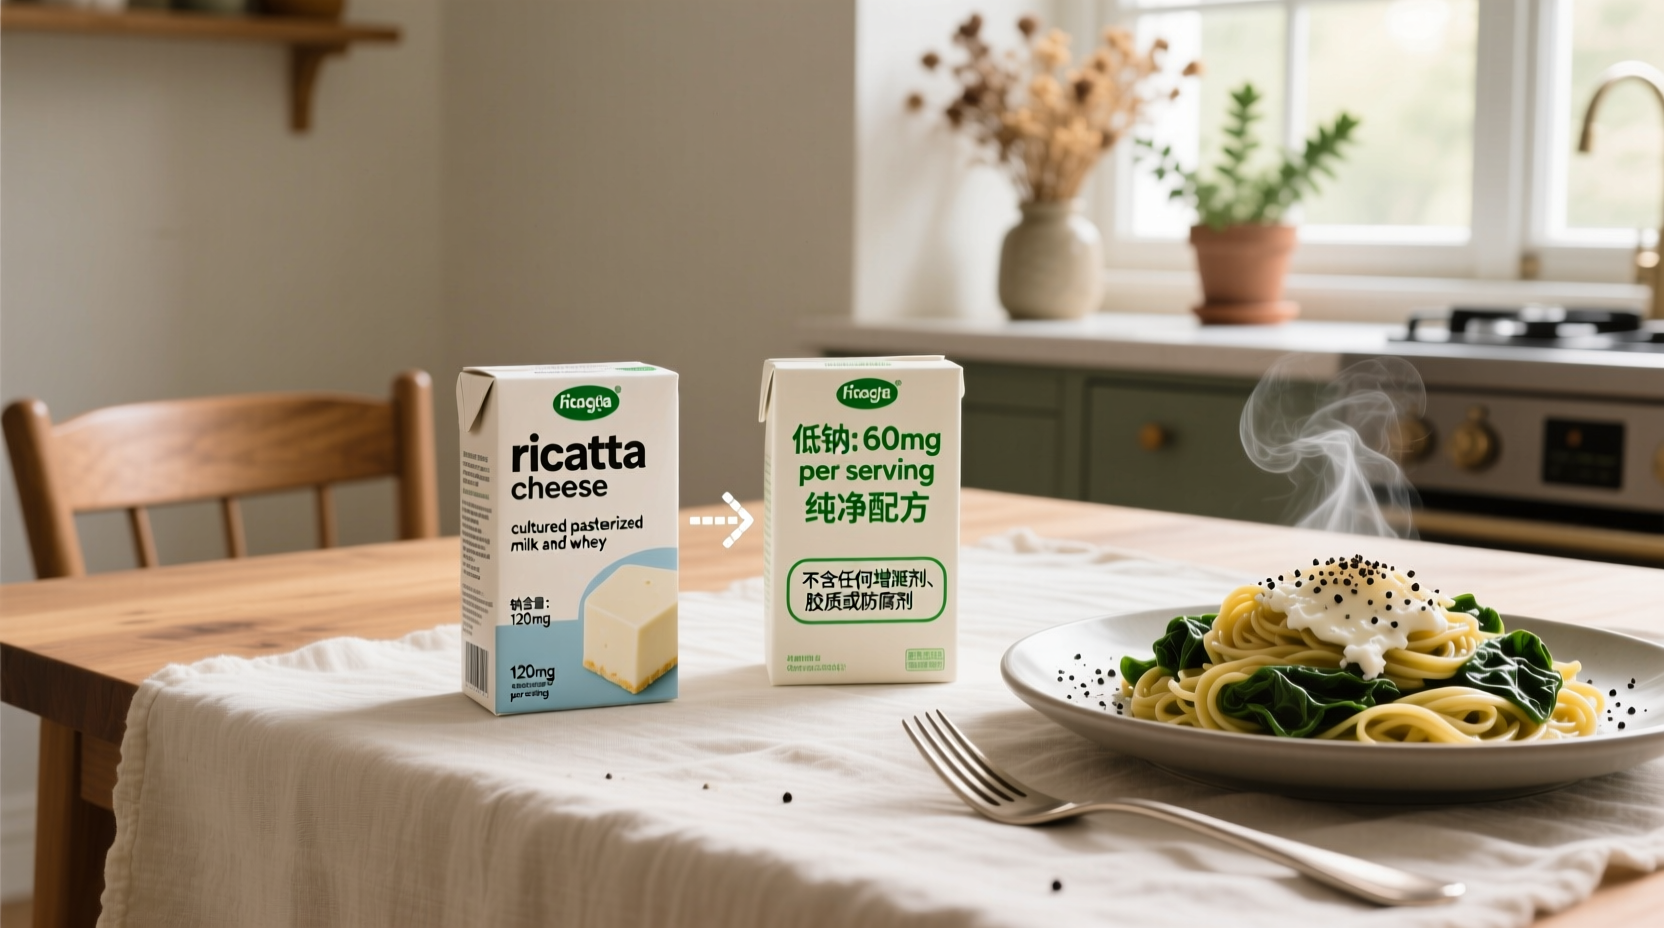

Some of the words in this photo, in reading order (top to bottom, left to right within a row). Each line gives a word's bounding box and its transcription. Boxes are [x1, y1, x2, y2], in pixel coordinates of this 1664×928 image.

[863, 425, 941, 456] 60mg
[512, 433, 646, 473] ricatta
[799, 464, 840, 487] per
[846, 457, 935, 487] serving
[511, 476, 608, 500] cheese
[805, 490, 930, 524] 纯净配方
[511, 518, 567, 535] cultured
[570, 515, 643, 535] pasterized
[511, 538, 539, 552] milk
[543, 535, 567, 551] and
[570, 536, 607, 551] whey
[510, 612, 551, 628] 120mg
[510, 664, 555, 681] 120mg
